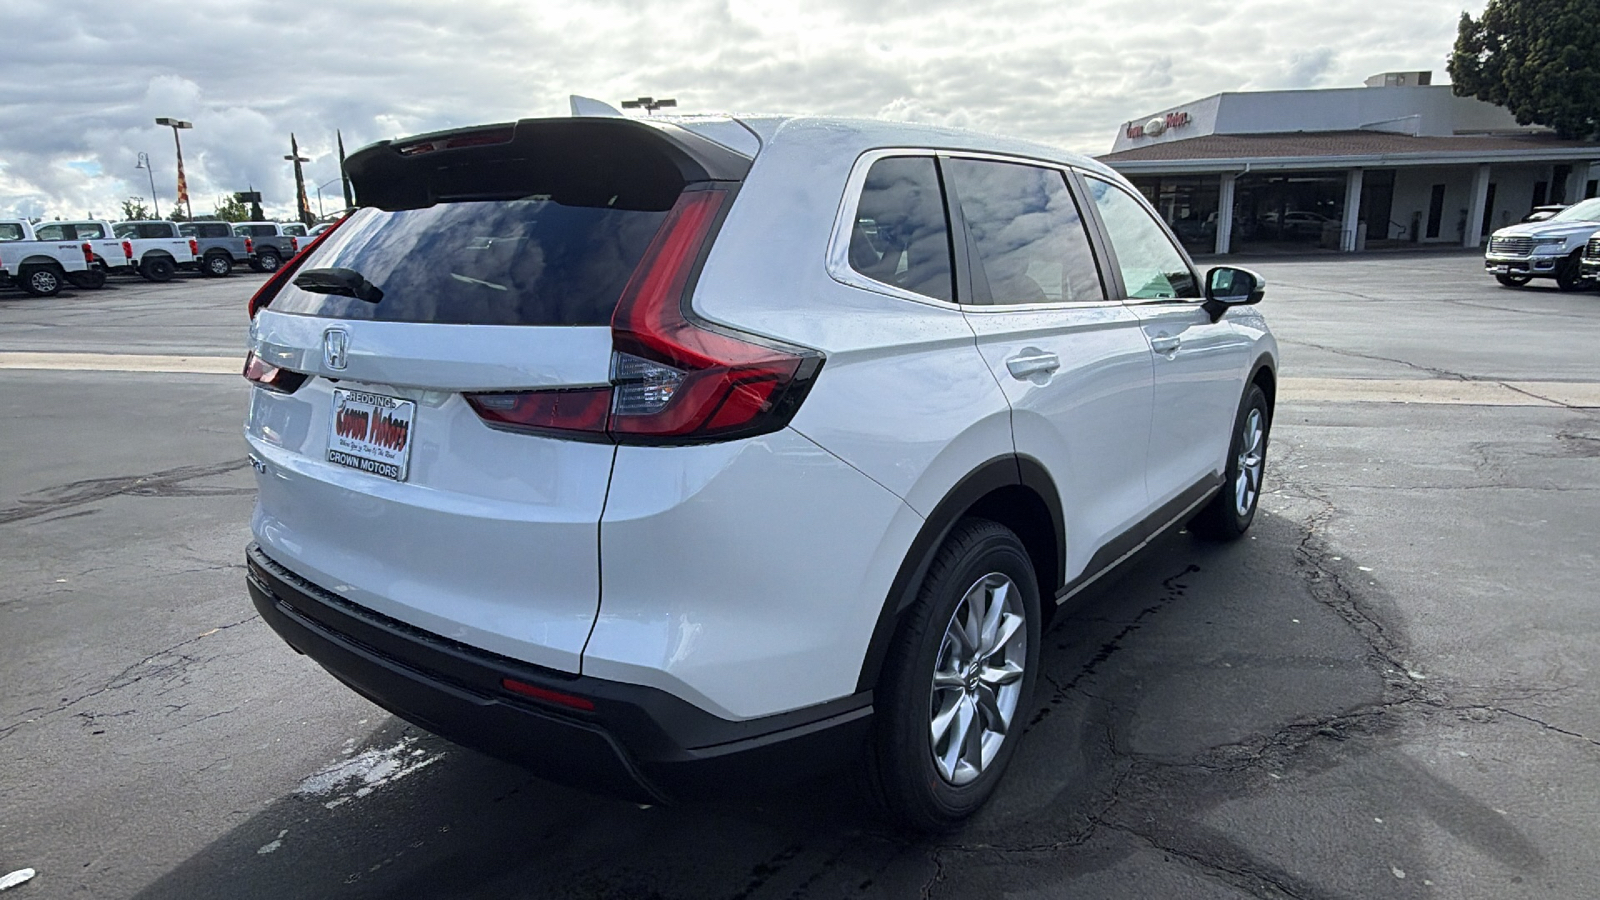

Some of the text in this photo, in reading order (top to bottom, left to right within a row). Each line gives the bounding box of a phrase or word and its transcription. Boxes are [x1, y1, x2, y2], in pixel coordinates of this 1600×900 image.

[349, 392, 393, 408] REDDING
[336, 400, 409, 452] Crown Motors
[329, 451, 398, 478] CROWN MOTORS
